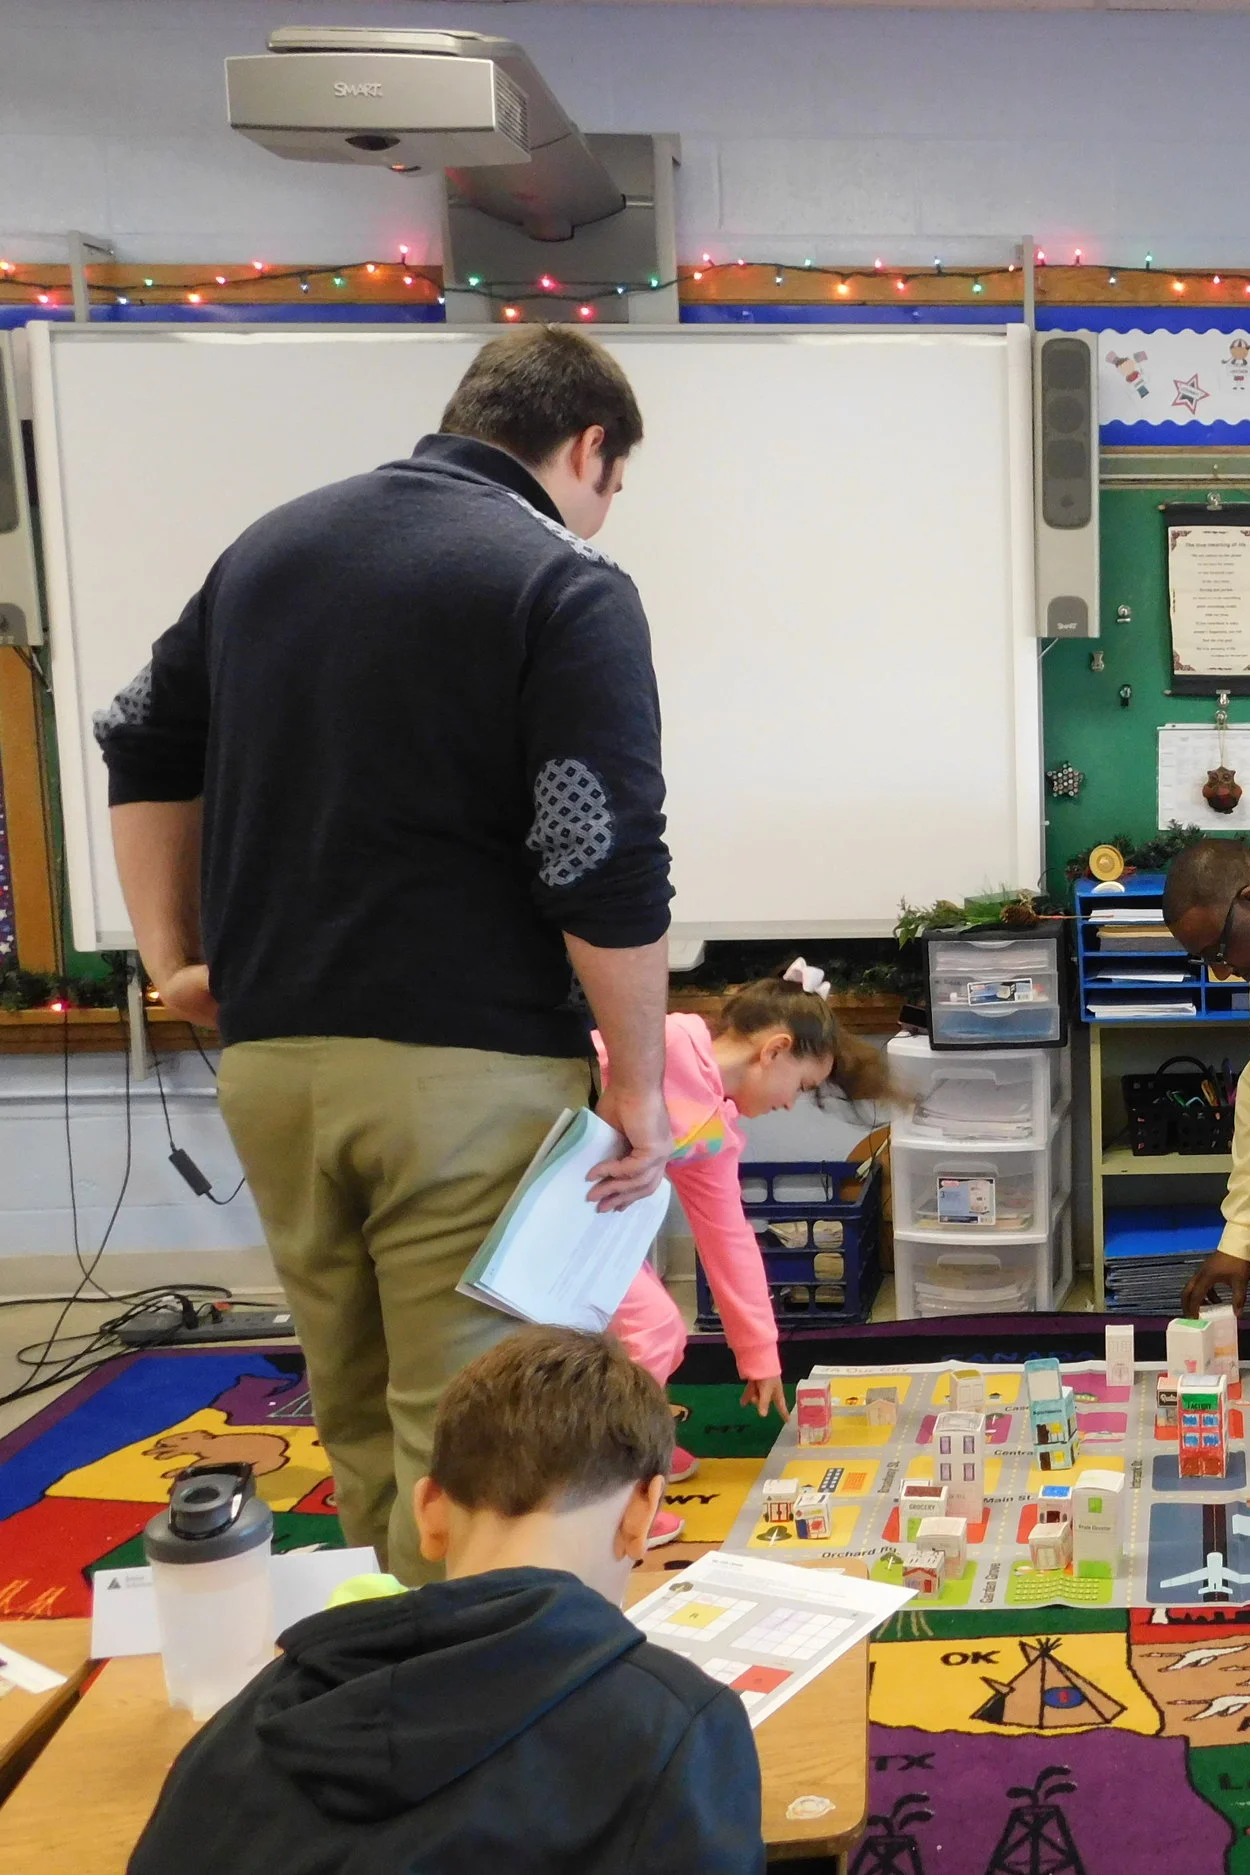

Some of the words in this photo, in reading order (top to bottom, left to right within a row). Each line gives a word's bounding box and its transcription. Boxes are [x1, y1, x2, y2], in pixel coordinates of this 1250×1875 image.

[663, 1493, 722, 1505] WY
[983, 1496, 1014, 1504] Main
[908, 1503, 936, 1512] GROCERY
[821, 1546, 876, 1559] Orchard
[940, 1650, 1001, 1666] OK
[869, 1752, 937, 1772] TX
